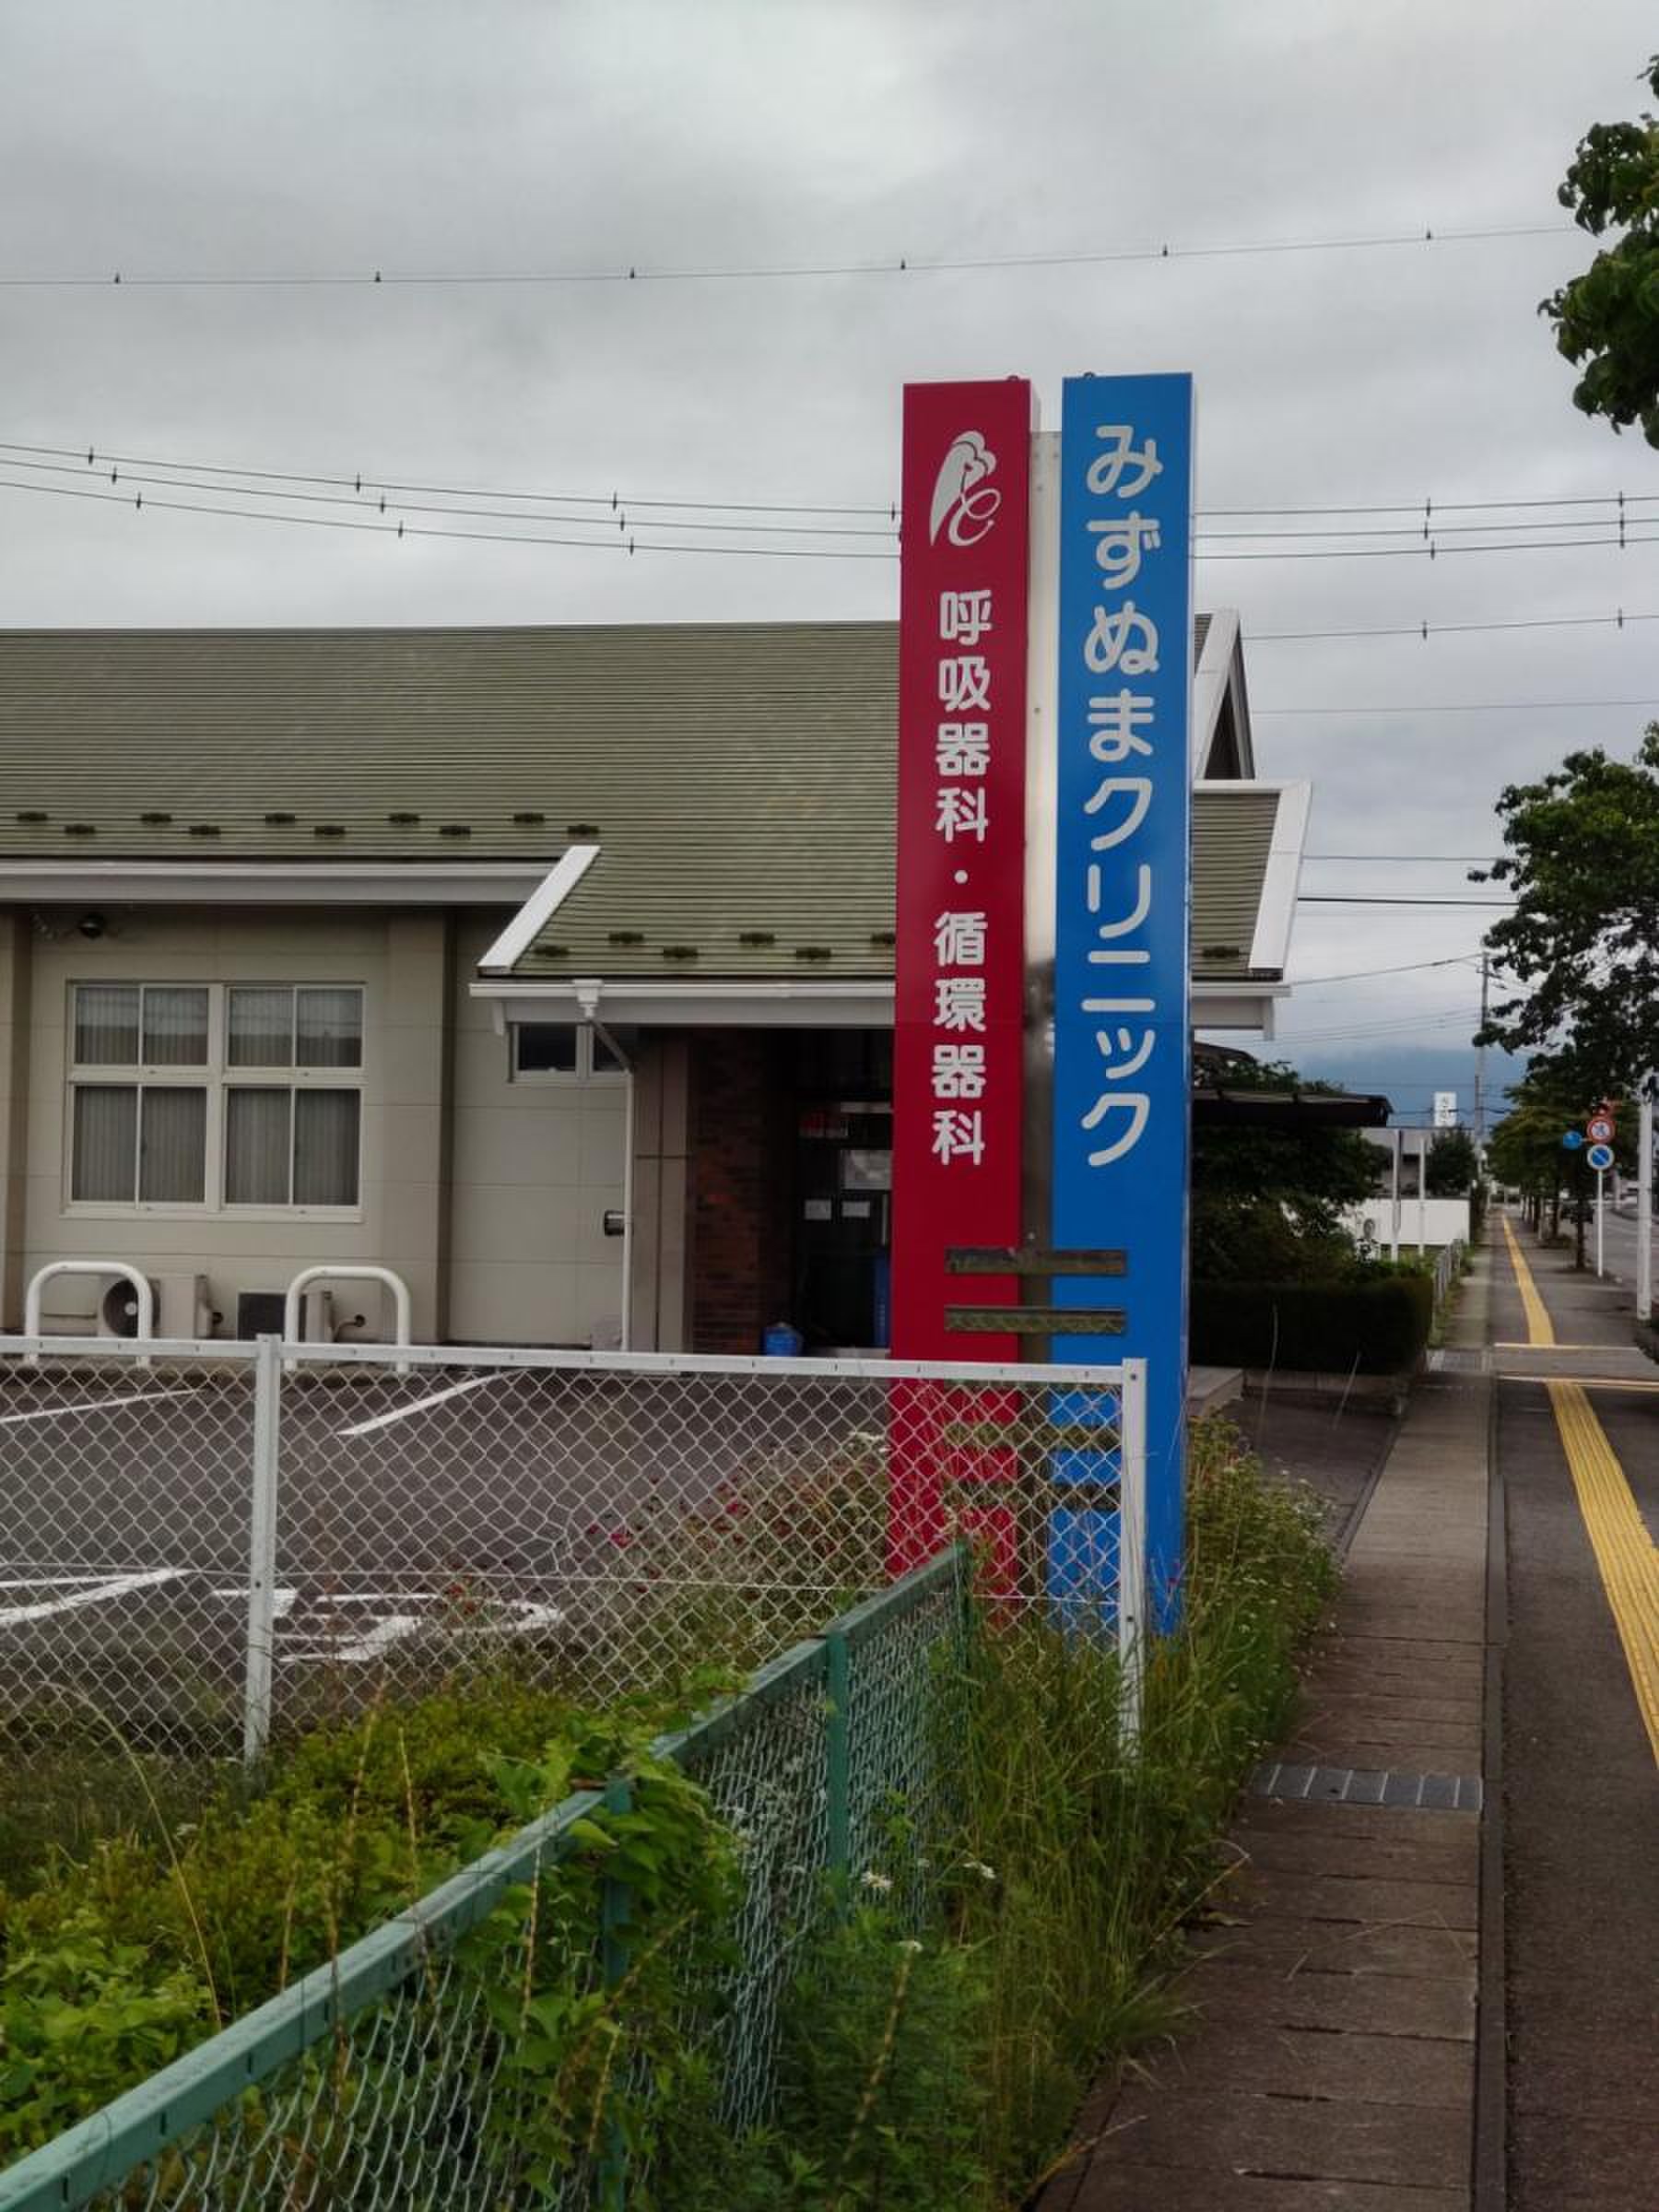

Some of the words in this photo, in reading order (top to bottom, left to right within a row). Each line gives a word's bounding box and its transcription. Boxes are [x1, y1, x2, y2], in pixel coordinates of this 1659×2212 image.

[931, 589, 993, 1166] 呼吸器科・循環器科
[1081, 425, 1164, 1166] みずぬまクリニック
